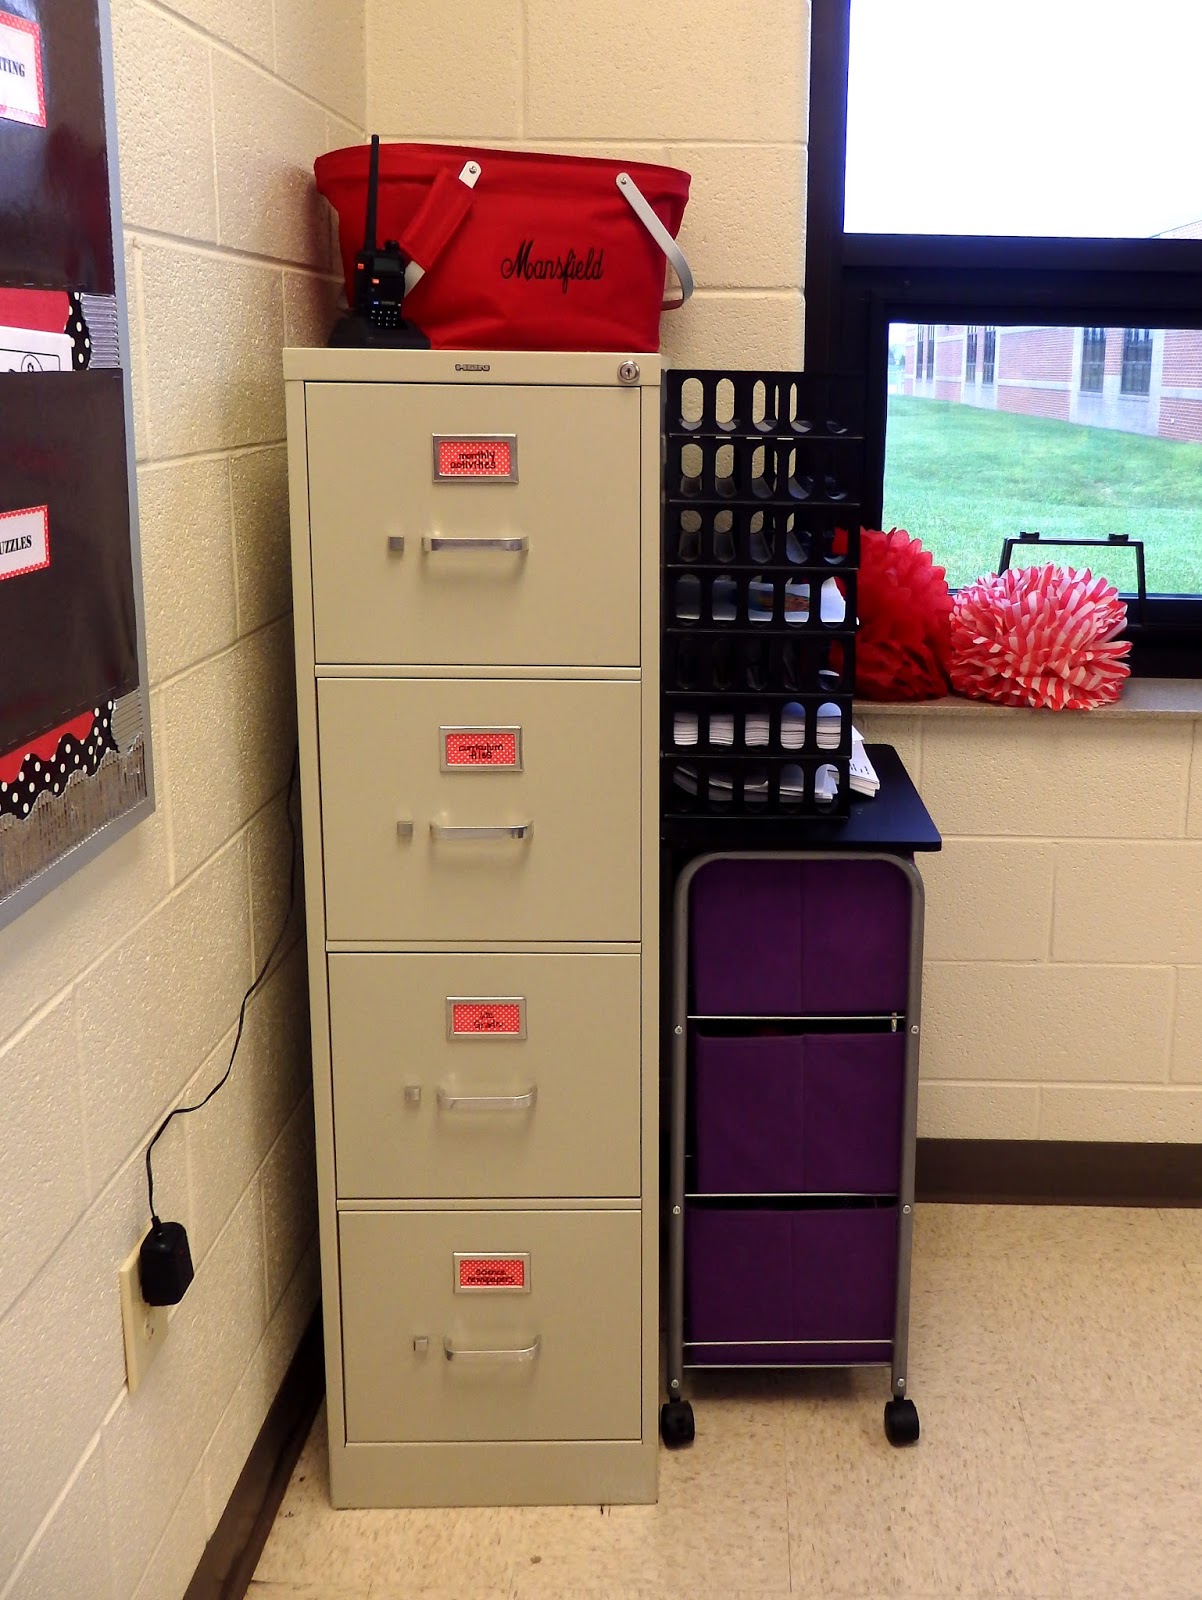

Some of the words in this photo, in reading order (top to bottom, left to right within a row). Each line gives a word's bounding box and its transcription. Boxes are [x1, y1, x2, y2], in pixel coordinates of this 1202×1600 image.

[500, 239, 605, 295] Mansfield
[458, 450, 495, 463] monthly
[450, 460, 496, 469] activities
[458, 742, 504, 752] curriculum
[469, 750, 493, 760] files
